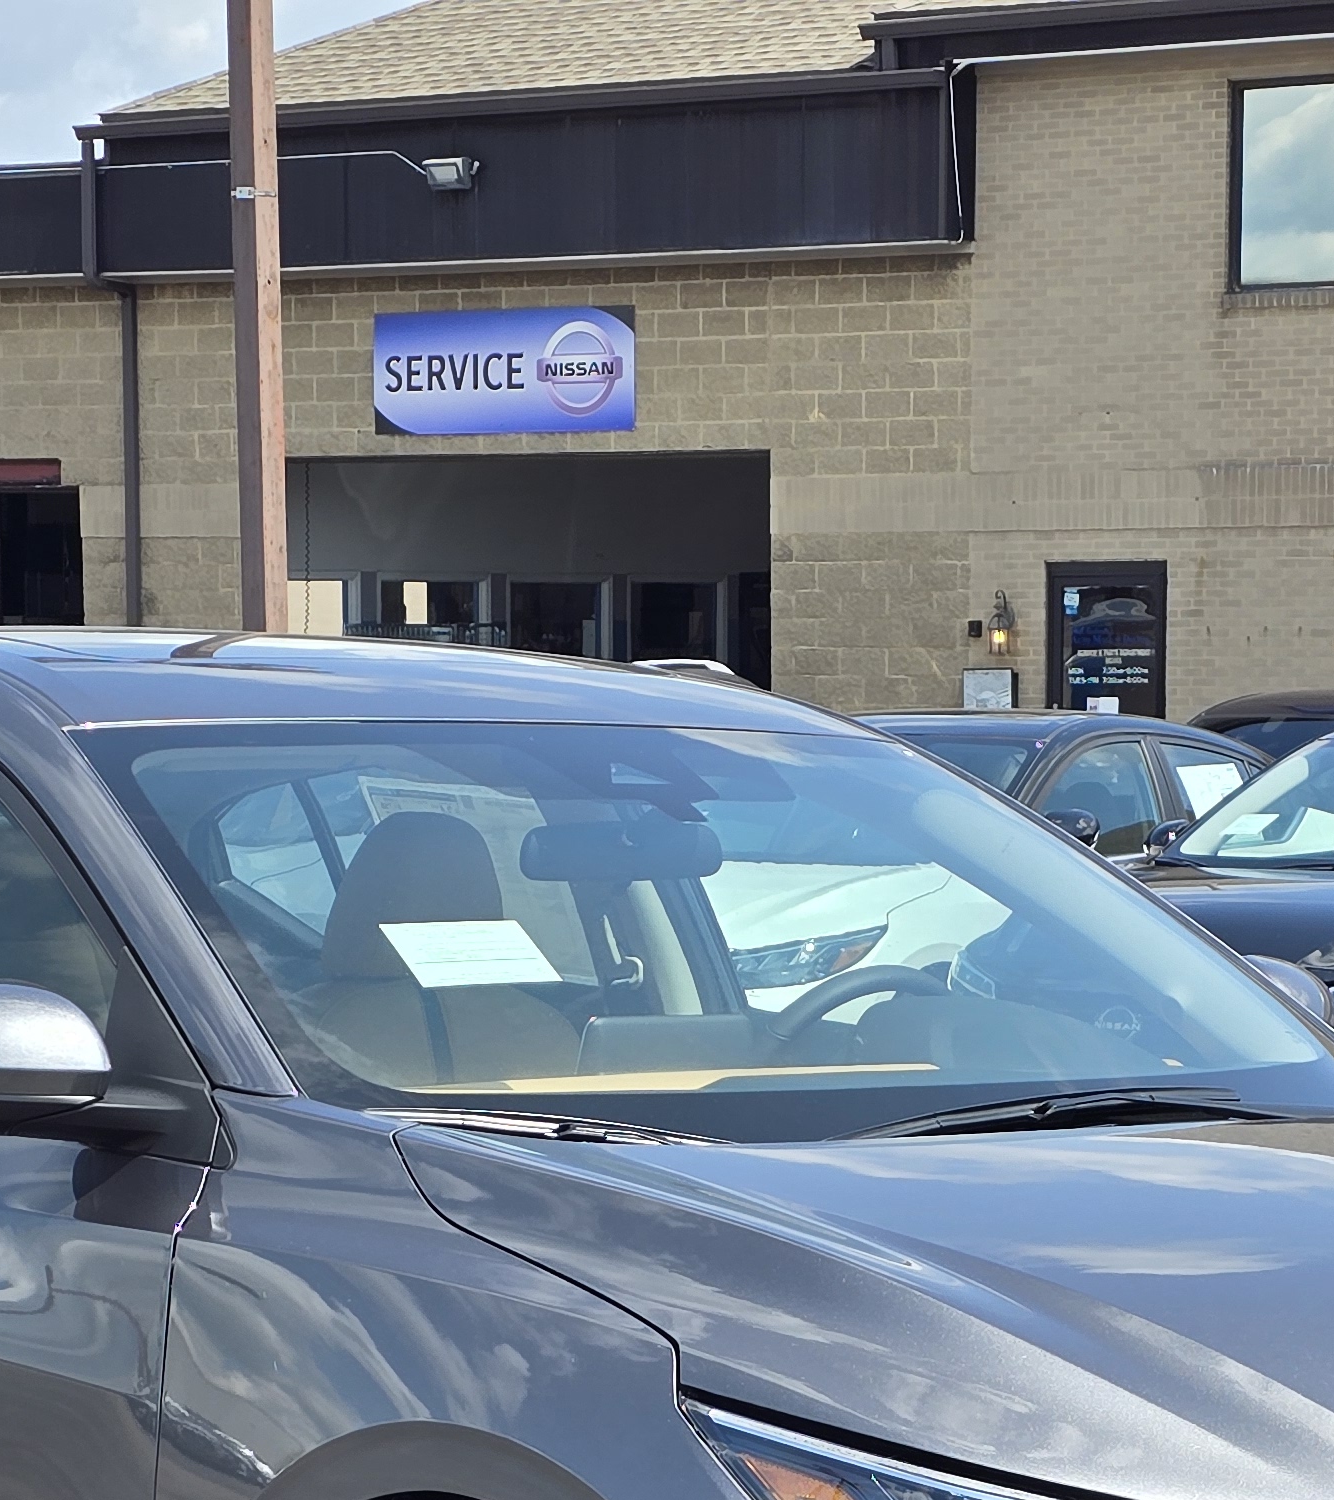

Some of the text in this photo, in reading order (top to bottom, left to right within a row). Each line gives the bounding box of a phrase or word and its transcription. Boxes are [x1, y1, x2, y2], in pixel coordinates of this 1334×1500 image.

[385, 352, 525, 392] SERVICE
[544, 361, 615, 378] NISSAN
[1094, 1020, 1141, 1031] NISSAN
